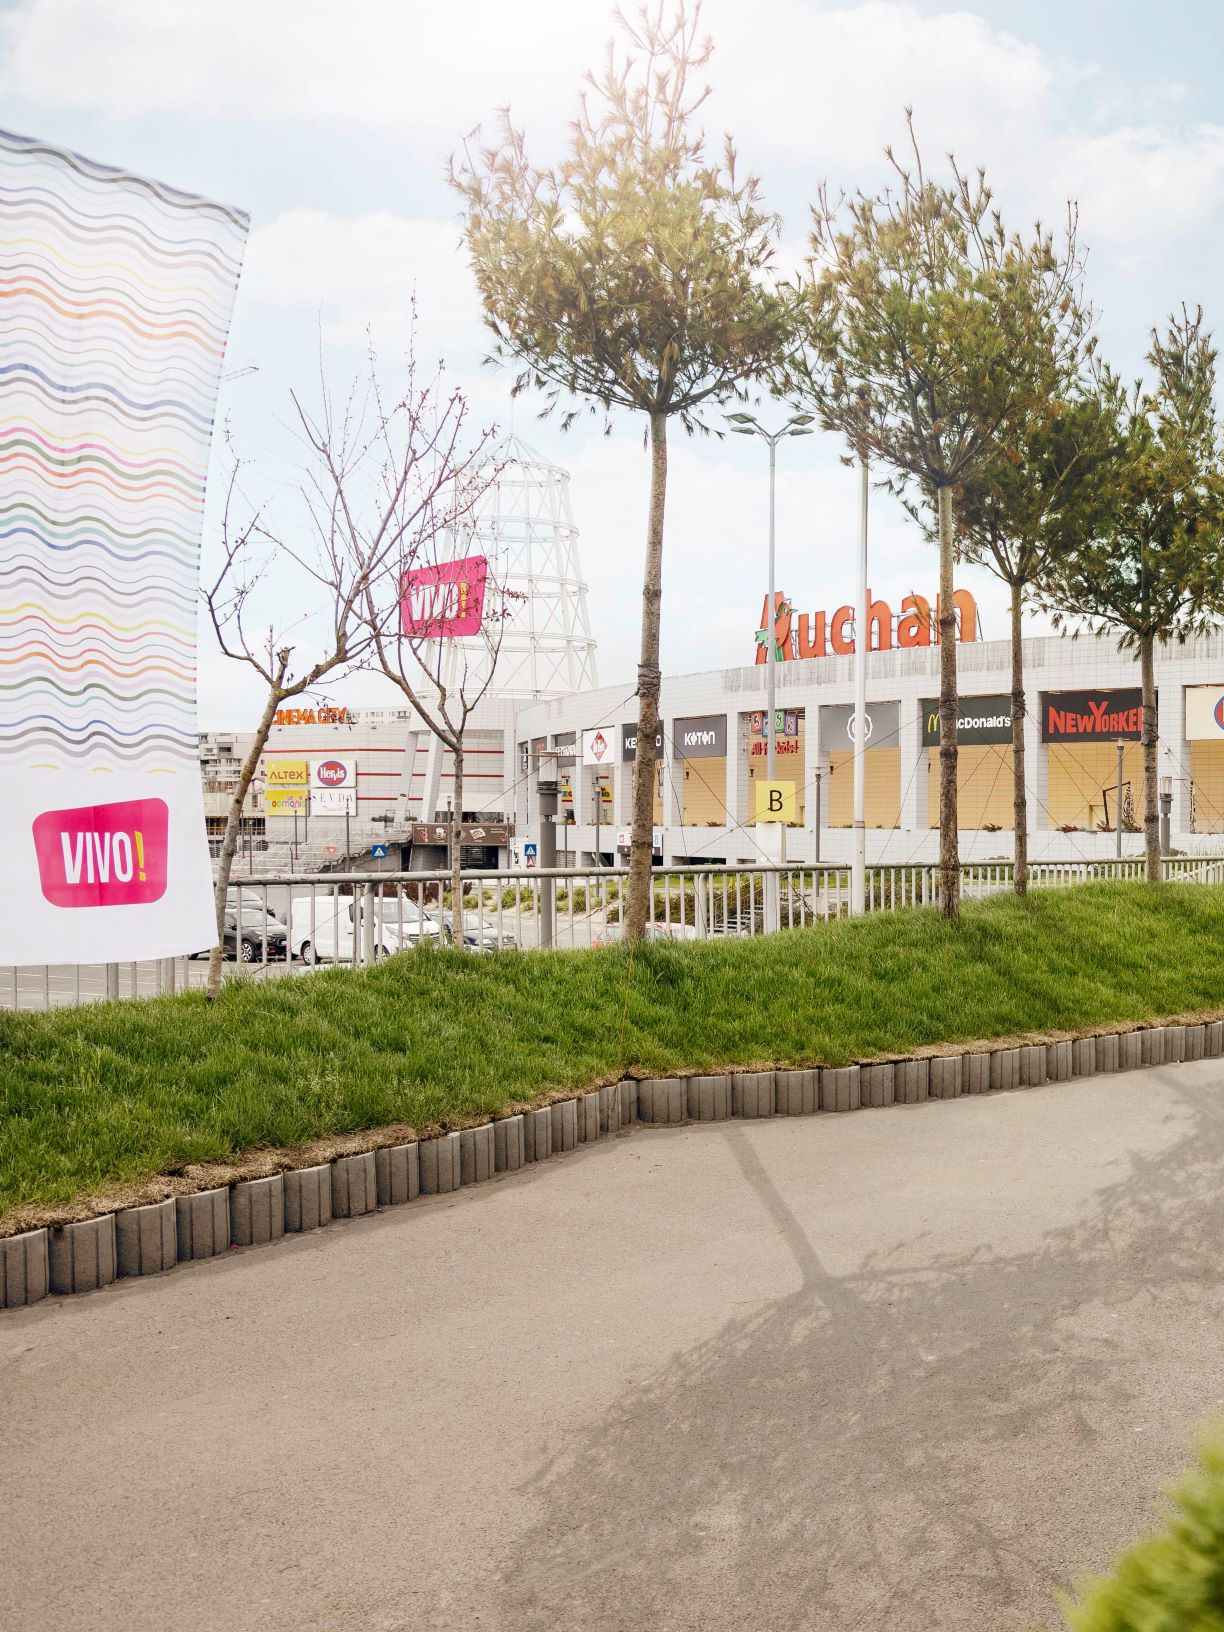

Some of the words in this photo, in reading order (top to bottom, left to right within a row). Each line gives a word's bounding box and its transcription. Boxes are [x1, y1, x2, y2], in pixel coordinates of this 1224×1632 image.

[410, 582, 467, 620] VIVO!
[756, 588, 977, 665] Auchan
[956, 716, 1012, 730] cDonald's
[320, 767, 345, 780] Hervis
[769, 789, 784, 812] B
[61, 830, 147, 884] VIVO!
